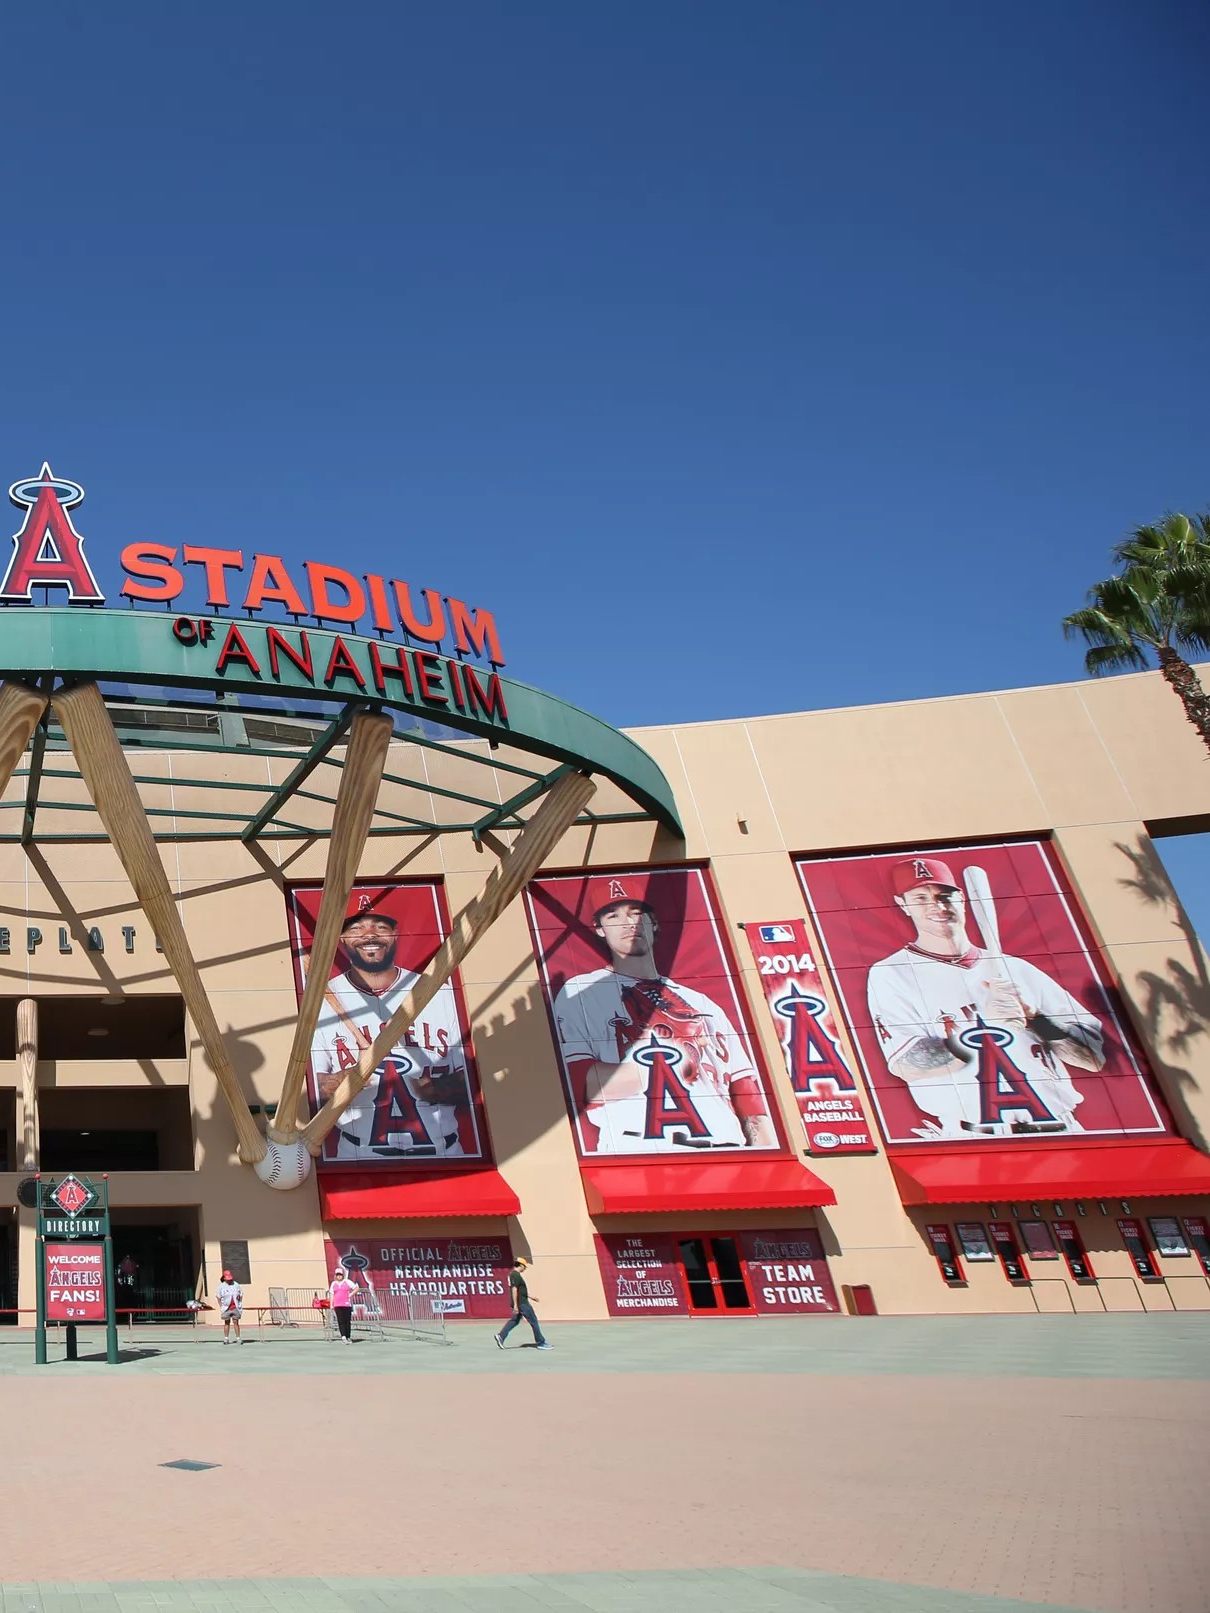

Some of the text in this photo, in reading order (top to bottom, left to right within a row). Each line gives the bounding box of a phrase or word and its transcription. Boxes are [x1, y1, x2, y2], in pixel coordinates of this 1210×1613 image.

[119, 542, 506, 667] STADIUM
[173, 617, 510, 727] OF ANAHEIM
[758, 953, 815, 975] 2014
[774, 981, 857, 1093] A
[960, 1013, 1058, 1124] A
[633, 1031, 713, 1139] A
[369, 1051, 435, 1146] A
[807, 1100, 853, 1111] ANGELS
[803, 1111, 864, 1123] BASEBALL
[839, 1134, 868, 1144] WEST
[65, 1181, 79, 1204] A
[46, 1220, 100, 1233] DIRECTORY
[381, 1240, 502, 1261] OFFICIAL ANGELS
[626, 1239, 643, 1247] THE
[754, 1237, 813, 1259] ANGELS
[48, 1256, 101, 1264] WELCOME
[617, 1249, 655, 1258] LARGEST
[394, 1264, 494, 1279] MERCHANDISE
[616, 1260, 662, 1268] SELECTION
[761, 1264, 815, 1282] TEAM
[49, 1265, 102, 1287] ANGELS
[636, 1270, 647, 1279] OF
[390, 1281, 504, 1296] HEADQUARTERS
[617, 1274, 675, 1297] ANGELS
[50, 1290, 101, 1302] FANS!
[616, 1298, 679, 1308] MERCHANDISE
[762, 1286, 826, 1304] STORE
